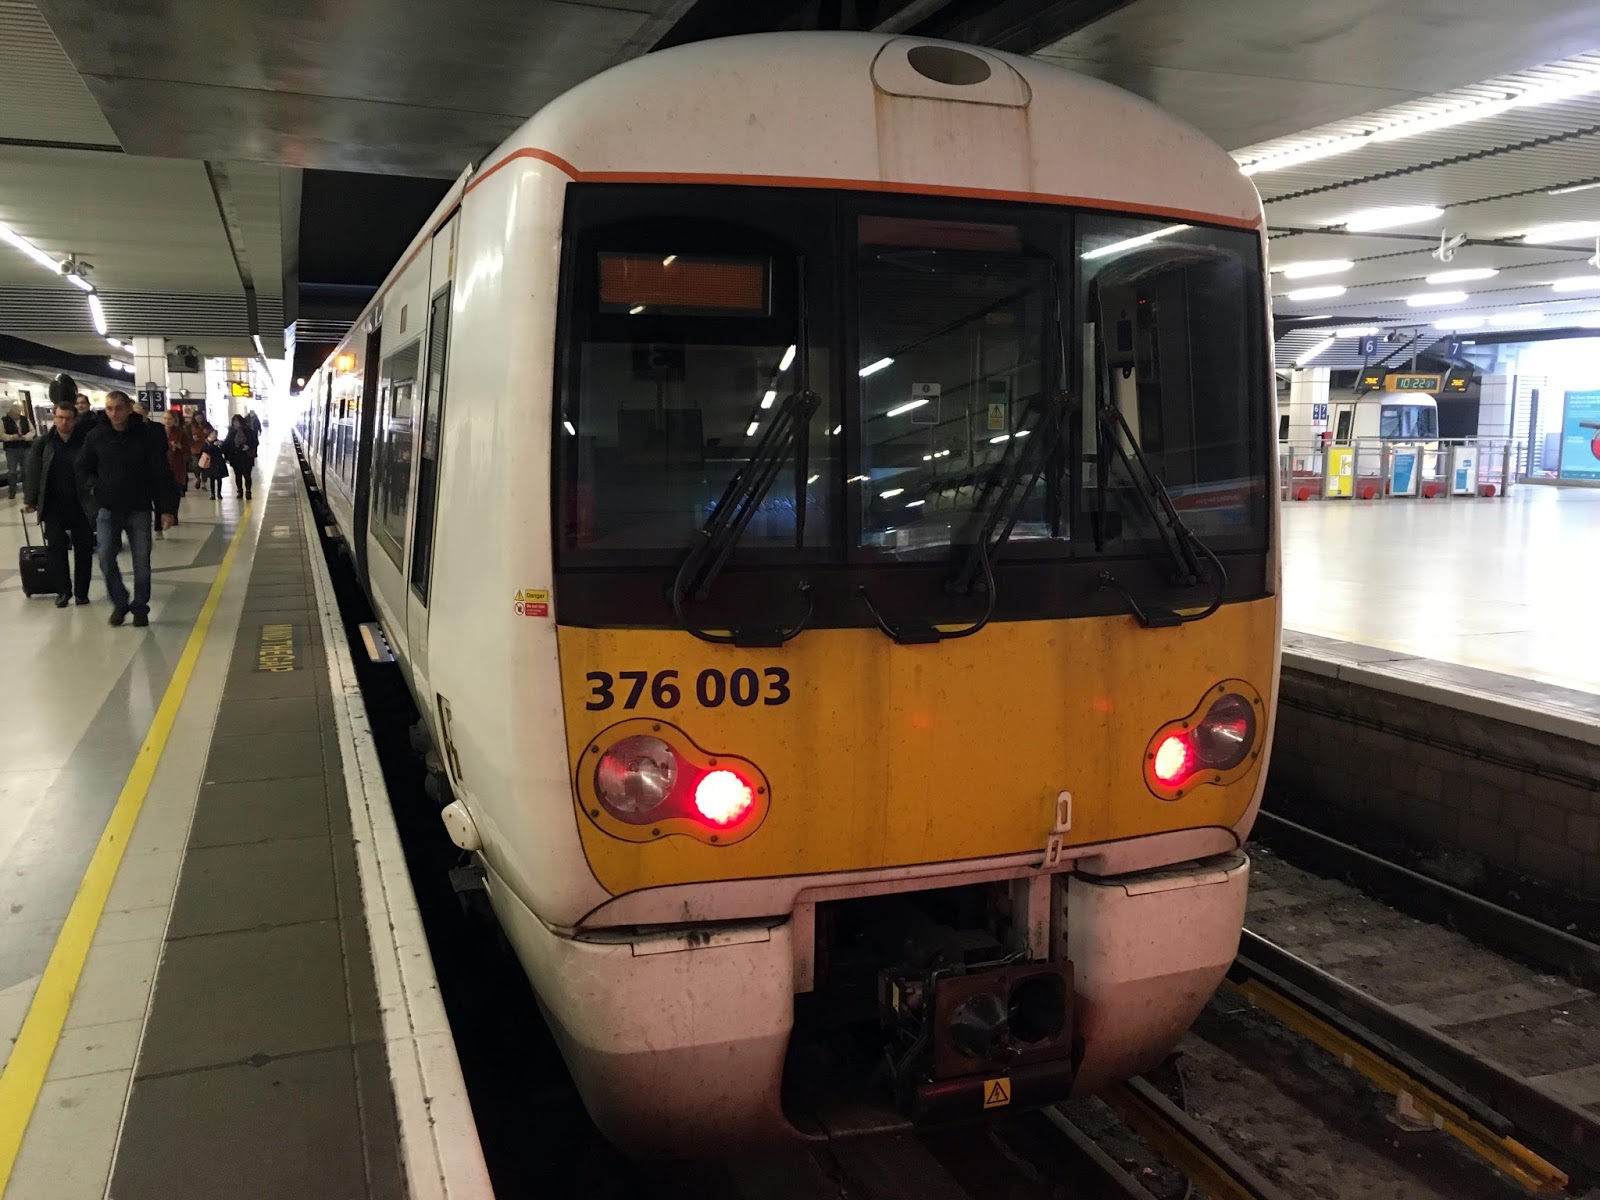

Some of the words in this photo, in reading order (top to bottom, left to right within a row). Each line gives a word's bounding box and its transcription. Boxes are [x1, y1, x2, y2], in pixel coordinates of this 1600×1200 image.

[1365, 340, 1374, 352] 6
[1452, 342, 1460, 355] 7
[140, 391, 148, 401] 2
[155, 391, 162, 401] 3
[1314, 404, 1319, 412] 6
[260, 640, 293, 655] THE
[259, 655, 296, 672] GAP
[585, 669, 681, 711] 376
[696, 666, 791, 708] 003
